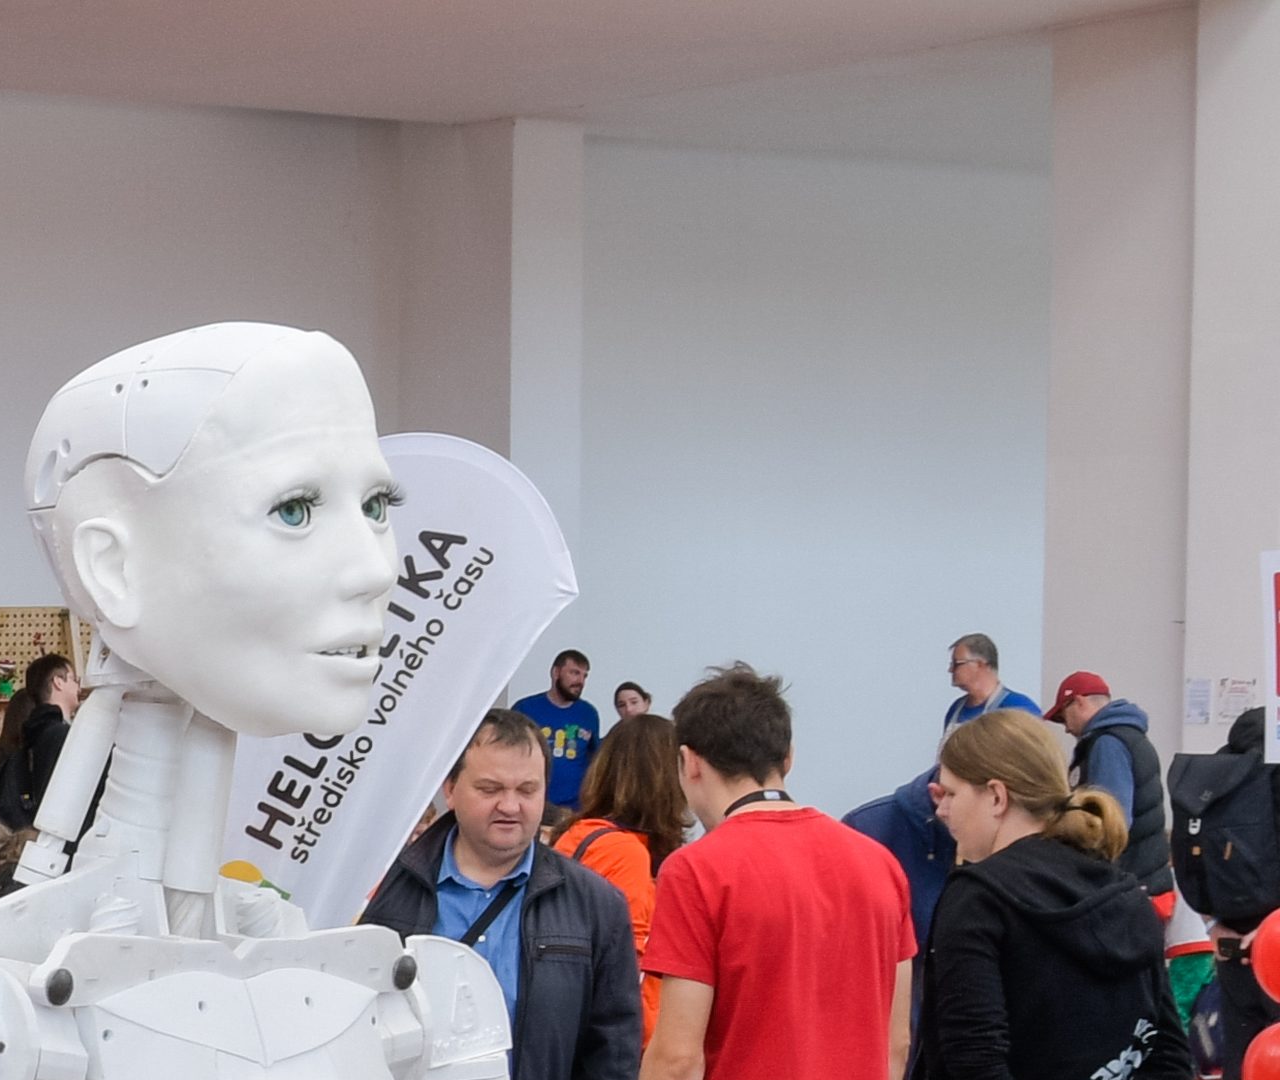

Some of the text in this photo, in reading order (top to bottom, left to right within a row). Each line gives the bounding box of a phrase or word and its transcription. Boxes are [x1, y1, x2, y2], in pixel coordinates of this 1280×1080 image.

[245, 530, 468, 850] HELKA
[290, 546, 495, 864] středisko volného času
